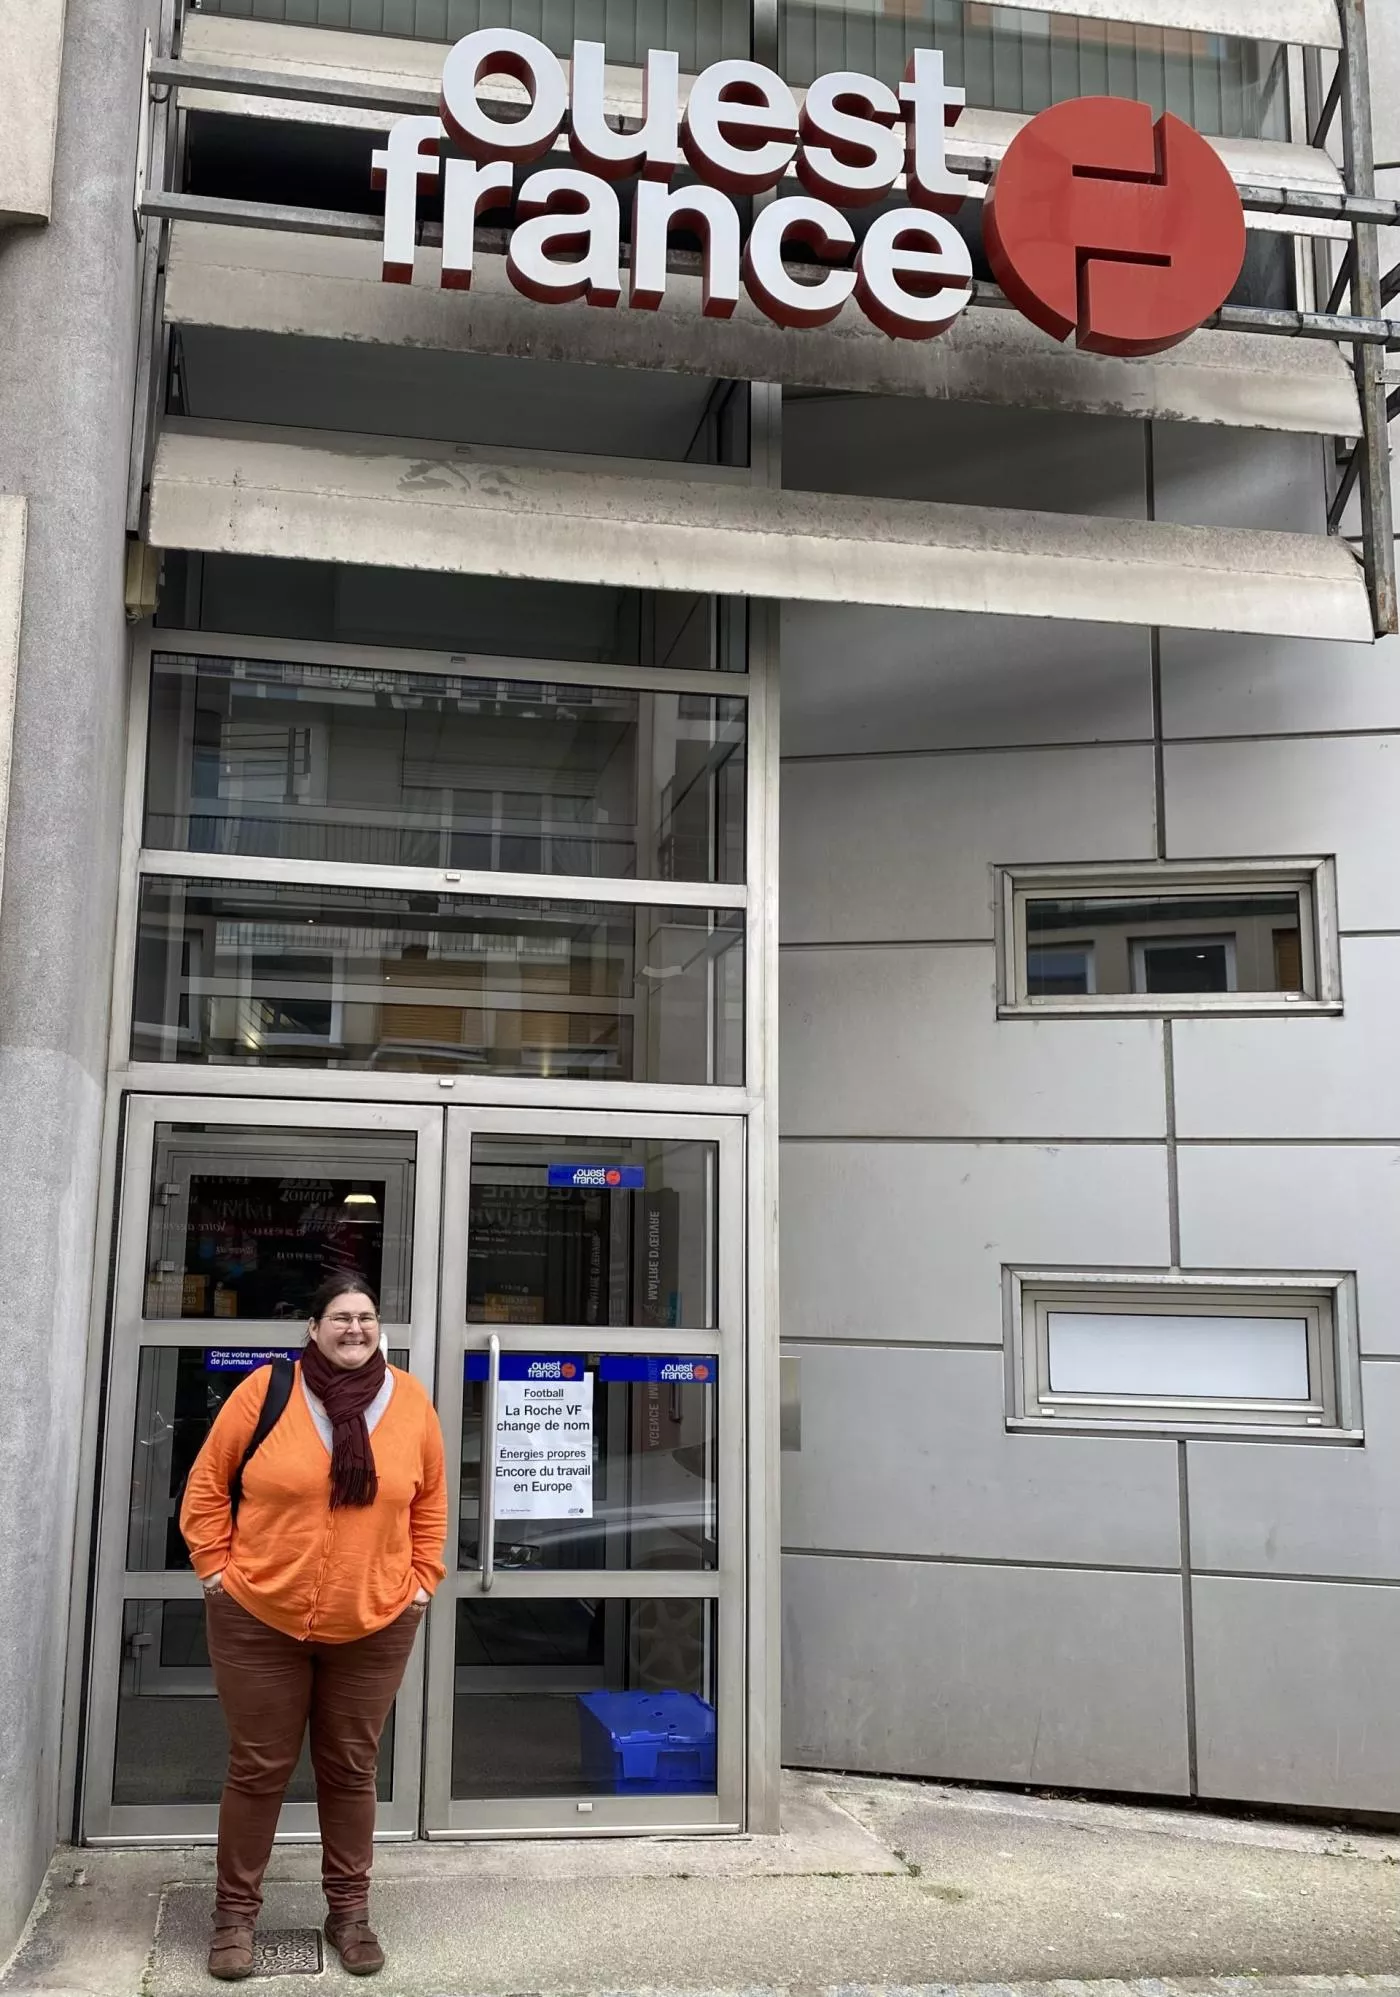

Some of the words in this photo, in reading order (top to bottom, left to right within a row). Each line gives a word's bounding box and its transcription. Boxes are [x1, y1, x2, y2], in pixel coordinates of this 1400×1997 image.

[440, 28, 968, 212] ouest
[371, 115, 973, 339] france
[577, 1168, 605, 1178] ouest
[573, 1174, 605, 1185] france
[221, 1358, 253, 1366] journaux
[531, 1362, 560, 1371] ouest
[528, 1368, 560, 1378] france
[664, 1363, 693, 1373] ouest
[661, 1370, 693, 1380] france
[524, 1388, 564, 1398] Football
[505, 1405, 520, 1416] La
[524, 1405, 562, 1416] Roche
[567, 1405, 582, 1416] VF
[497, 1421, 540, 1433] change
[545, 1420, 560, 1431] de
[564, 1422, 590, 1431] nom
[500, 1447, 544, 1460] Énergies
[547, 1450, 586, 1460] propres
[496, 1467, 536, 1477] Encore
[540, 1466, 554, 1477] du
[557, 1465, 591, 1476] travail
[514, 1483, 528, 1492] en
[532, 1481, 572, 1493] Europe
